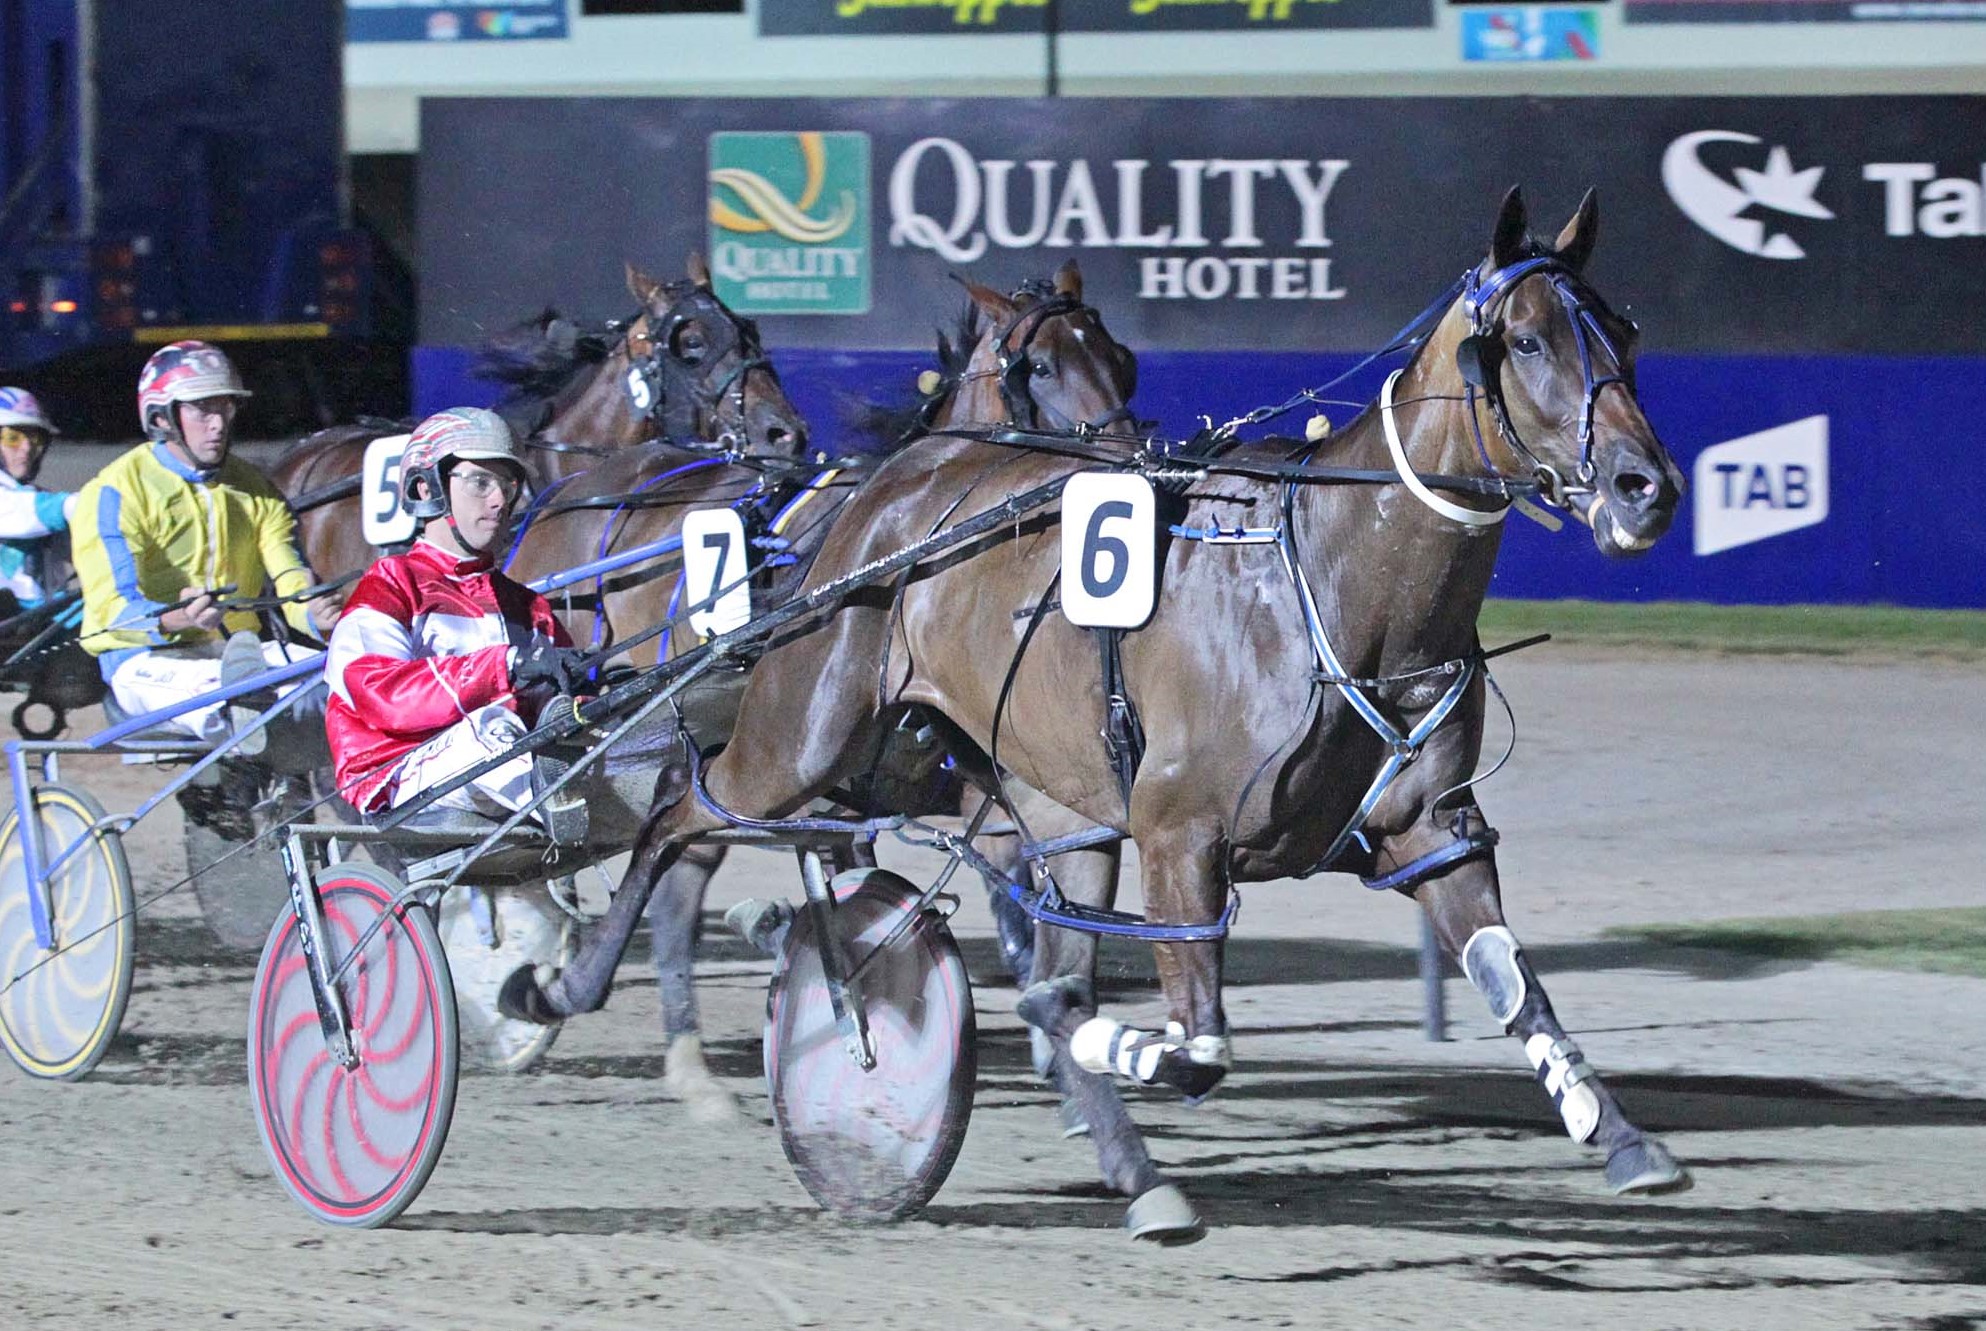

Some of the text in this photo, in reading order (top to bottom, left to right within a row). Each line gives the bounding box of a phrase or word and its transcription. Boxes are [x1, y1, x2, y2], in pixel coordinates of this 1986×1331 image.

[889, 136, 1350, 263] QUALITY
[1862, 162, 1986, 239] Ta
[714, 241, 863, 282] QUALITY
[1139, 257, 1347, 300] HOTEL
[628, 368, 651, 409] 5
[375, 454, 404, 523] 5
[1711, 462, 1810, 510] TAB
[702, 532, 731, 613] 7
[1080, 500, 1134, 599] 6
